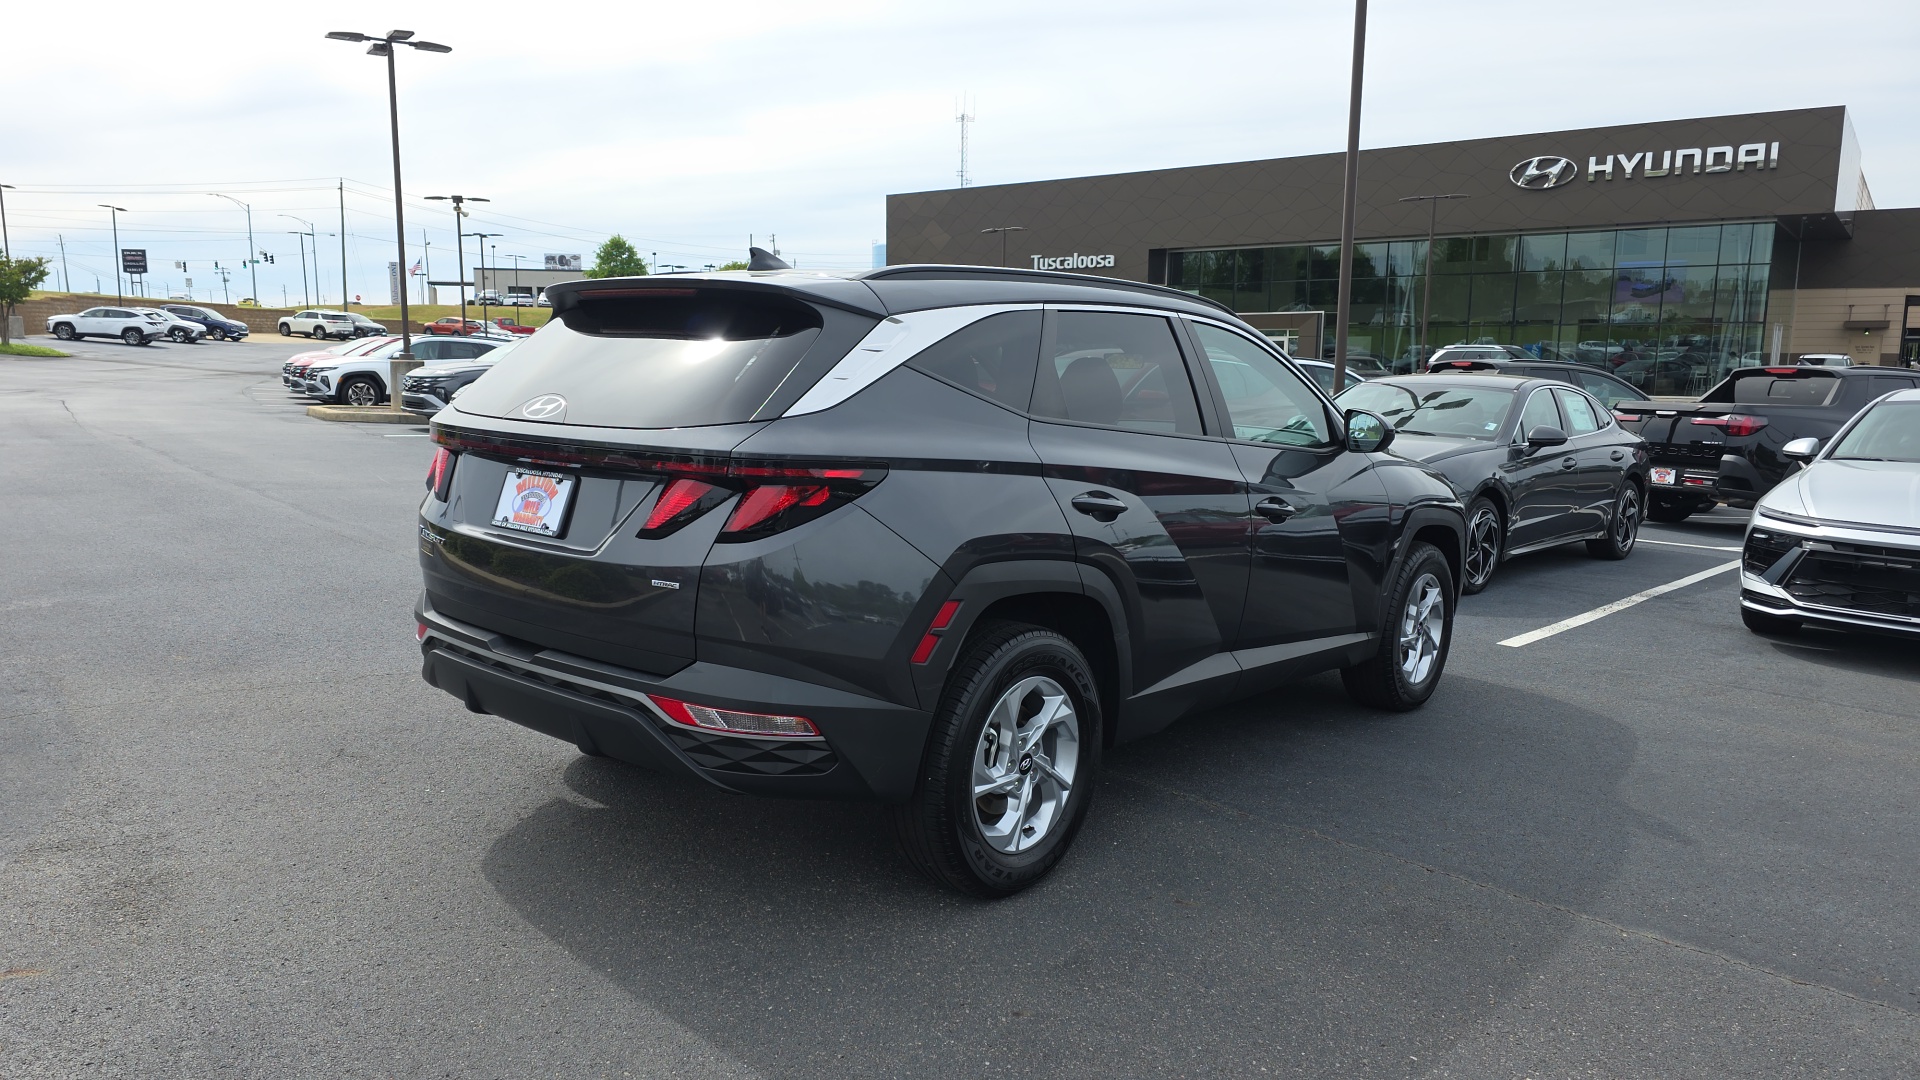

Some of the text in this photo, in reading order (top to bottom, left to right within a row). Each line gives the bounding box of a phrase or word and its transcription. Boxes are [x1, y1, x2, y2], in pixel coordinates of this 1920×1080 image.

[1587, 141, 1779, 182] HYUNDAI
[1030, 252, 1115, 270] Tuscaloosa
[515, 475, 559, 501] MILLION
[522, 500, 540, 515] MILE
